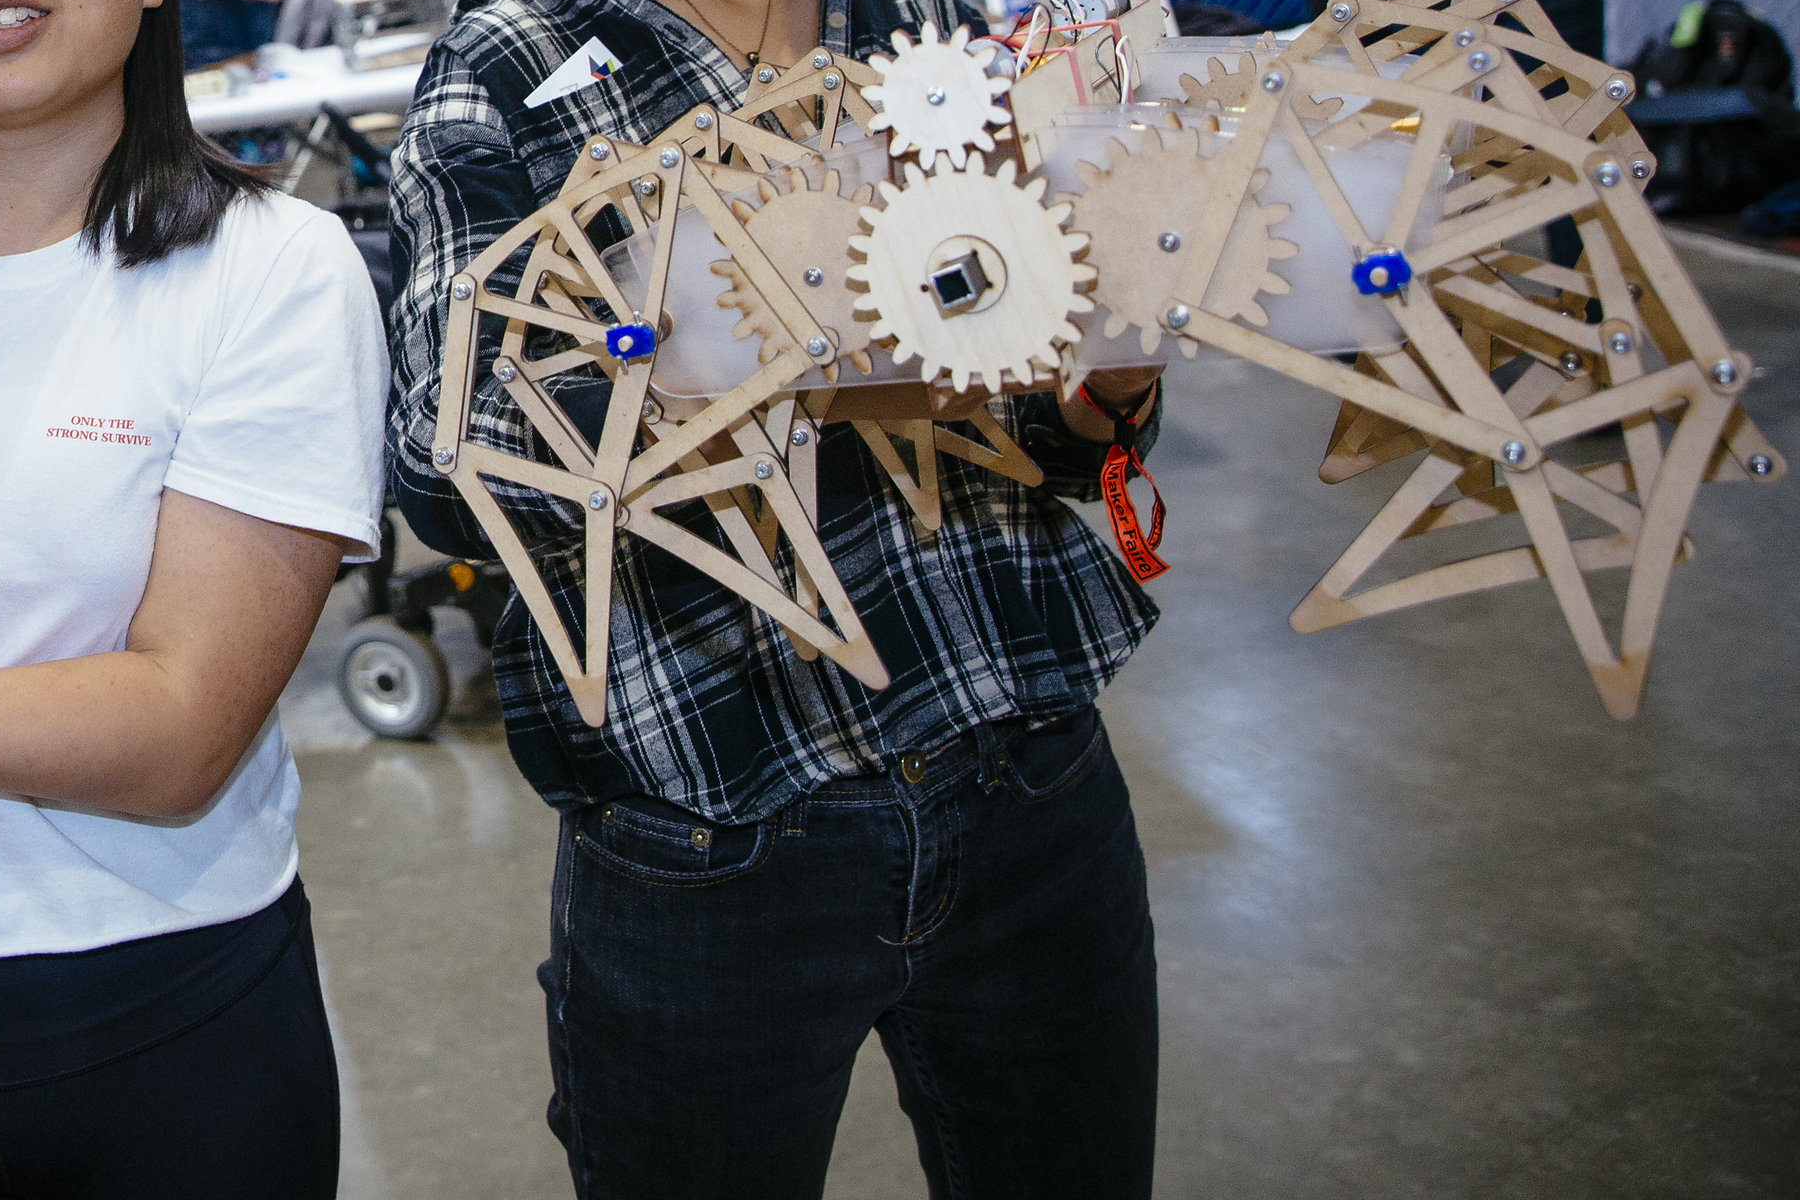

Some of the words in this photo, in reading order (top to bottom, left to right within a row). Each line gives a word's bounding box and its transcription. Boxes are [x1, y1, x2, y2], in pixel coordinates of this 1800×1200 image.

[71, 415, 105, 428] ONLY
[108, 419, 134, 430] THE
[46, 427, 98, 441] STRONG
[101, 432, 152, 446] SURVIVE
[1106, 464, 1129, 523] Maker
[1123, 529, 1151, 574] Faire
